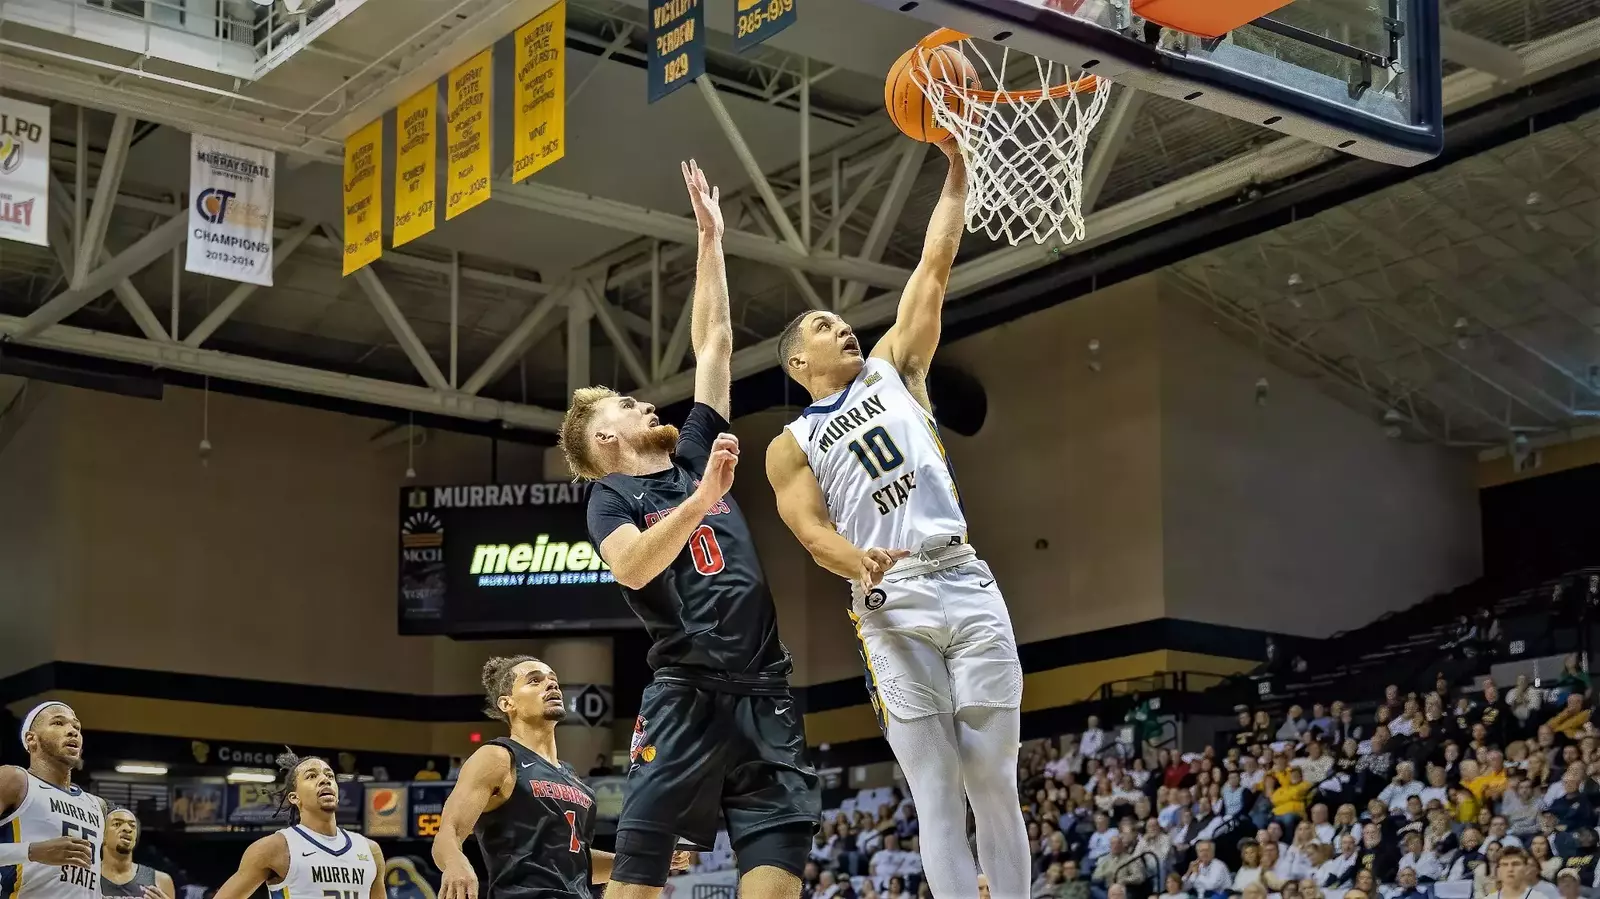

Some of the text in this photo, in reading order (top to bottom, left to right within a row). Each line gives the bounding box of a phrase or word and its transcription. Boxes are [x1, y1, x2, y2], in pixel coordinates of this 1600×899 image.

[664, 53, 688, 84] 1929
[197, 151, 270, 179] MURRAY STATE
[194, 228, 269, 254] CHAMPIONS
[819, 394, 887, 454] MURRAY
[848, 425, 905, 481] 10
[433, 483, 584, 508] MURRAY STAT
[689, 525, 725, 576] 0
[478, 574, 526, 587] MURRAY
[527, 573, 557, 586] AUTO
[560, 572, 598, 585] REPAIR
[584, 693, 603, 718] D
[218, 746, 274, 765] Conce
[49, 797, 100, 829] MURRAY
[563, 810, 581, 853] 1
[59, 864, 97, 891] STATE
[311, 865, 365, 886] MURRAY
